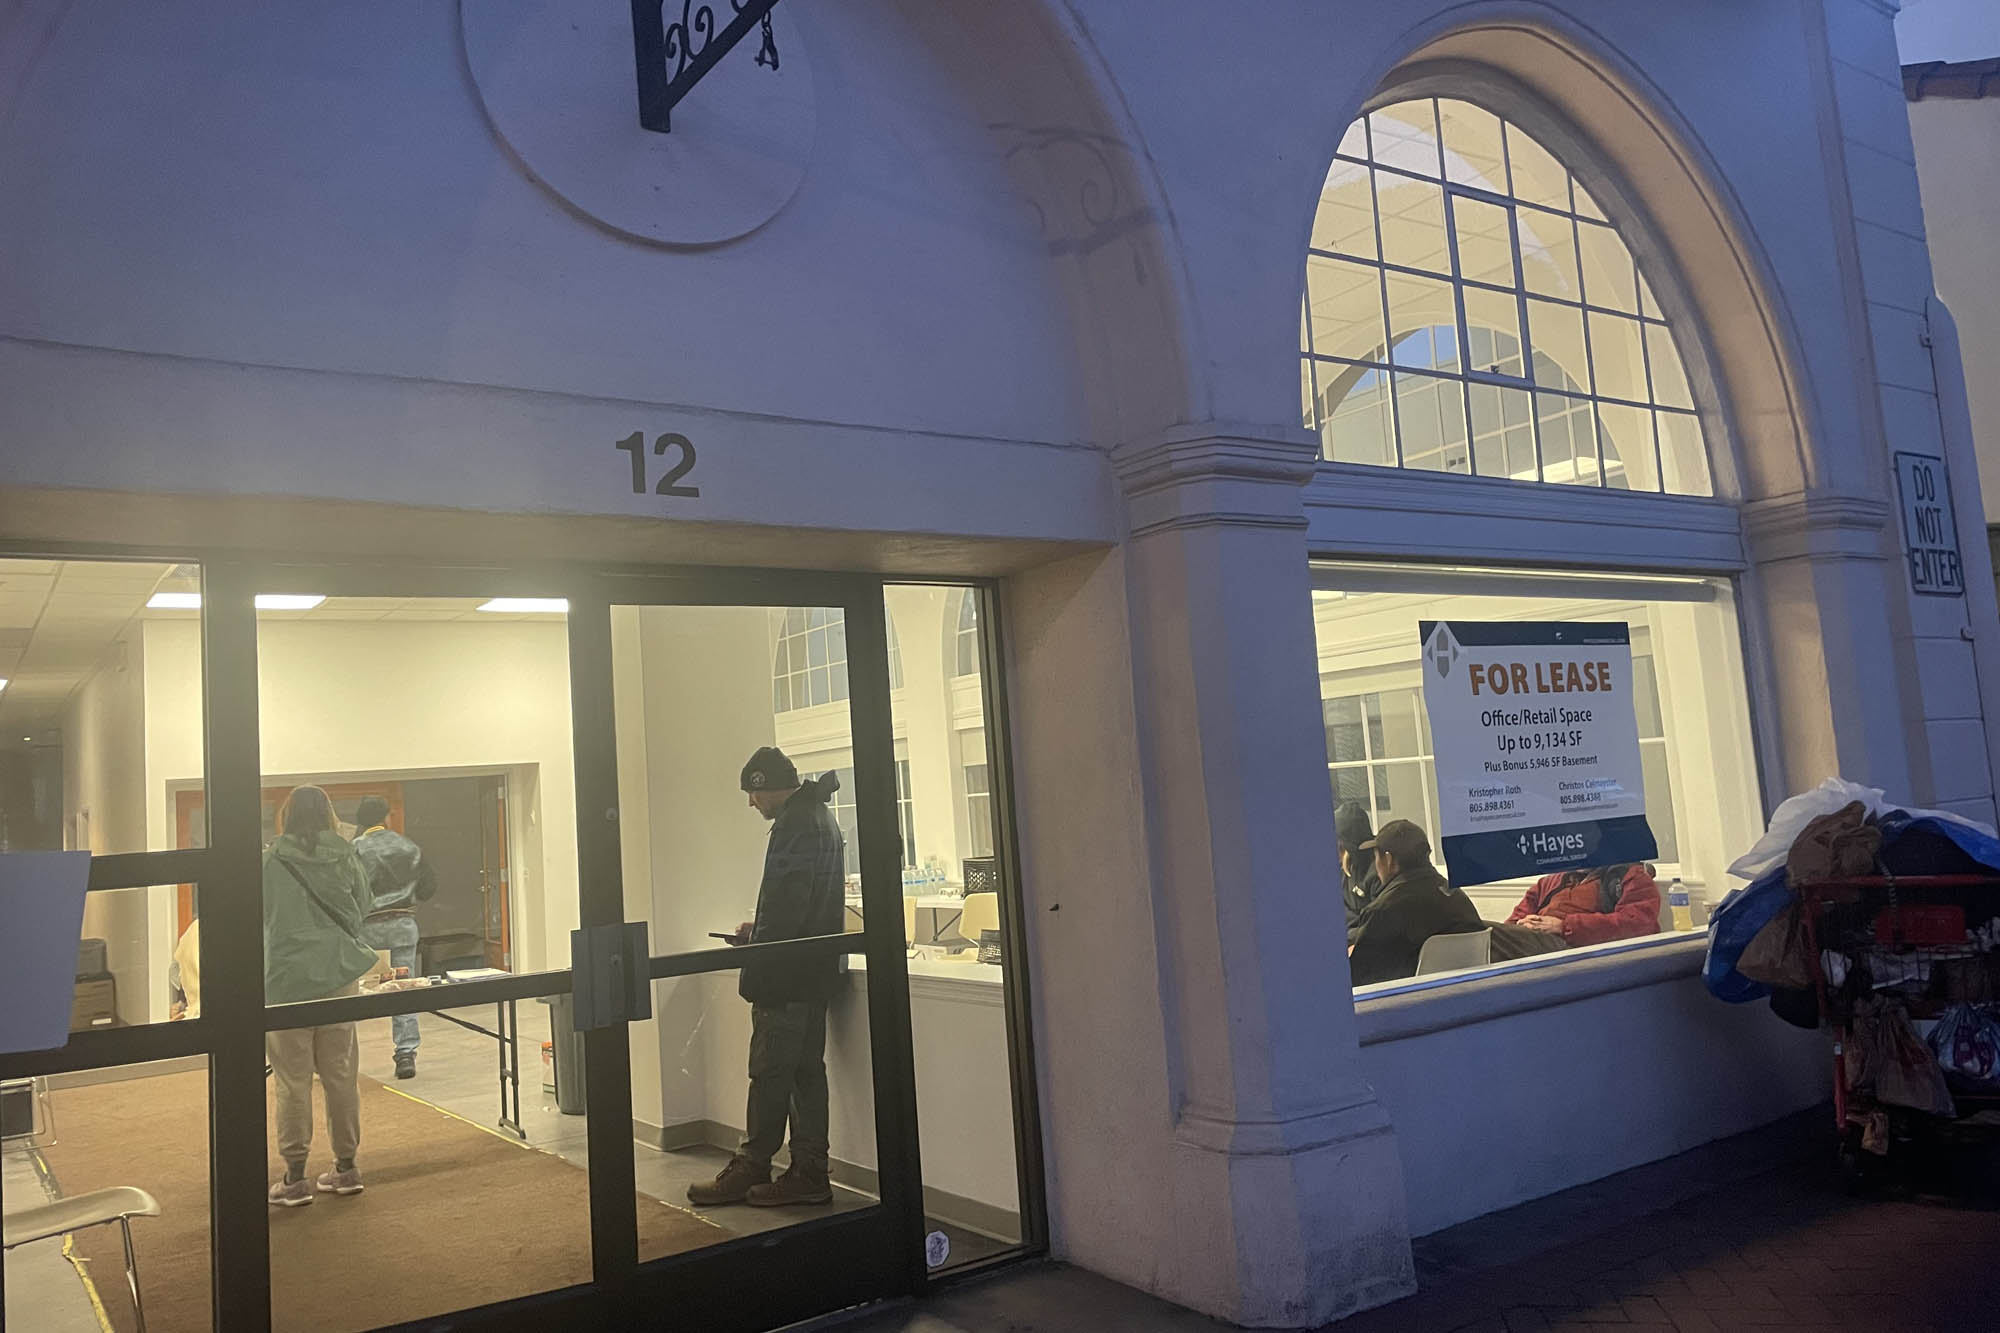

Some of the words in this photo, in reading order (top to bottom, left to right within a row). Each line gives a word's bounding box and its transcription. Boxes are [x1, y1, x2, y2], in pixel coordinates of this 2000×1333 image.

[616, 431, 700, 498] 12
[1912, 464, 1935, 502] DO
[1914, 505, 1945, 545] NOT
[1910, 547, 1961, 588] ENTER
[1469, 663, 1530, 696] FOR
[1535, 661, 1613, 694] LEASE
[1481, 707, 1558, 727] Office/Retail
[1559, 708, 1593, 727] Space
[1497, 735, 1516, 754] Up
[1519, 736, 1532, 750] to
[1534, 732, 1567, 752] 9,134
[1569, 730, 1583, 746] SF
[1484, 760, 1502, 773] Plus
[1503, 759, 1529, 772] Bonus
[1530, 757, 1550, 771] 5,946
[1551, 756, 1561, 768] SF
[1562, 755, 1598, 767] Basement
[1469, 786, 1504, 799] Kristopher
[1505, 785, 1522, 797] Roth
[1558, 779, 1585, 792] Christos
[1469, 800, 1515, 813] 805.898.4361
[1532, 832, 1584, 855] Hayes
